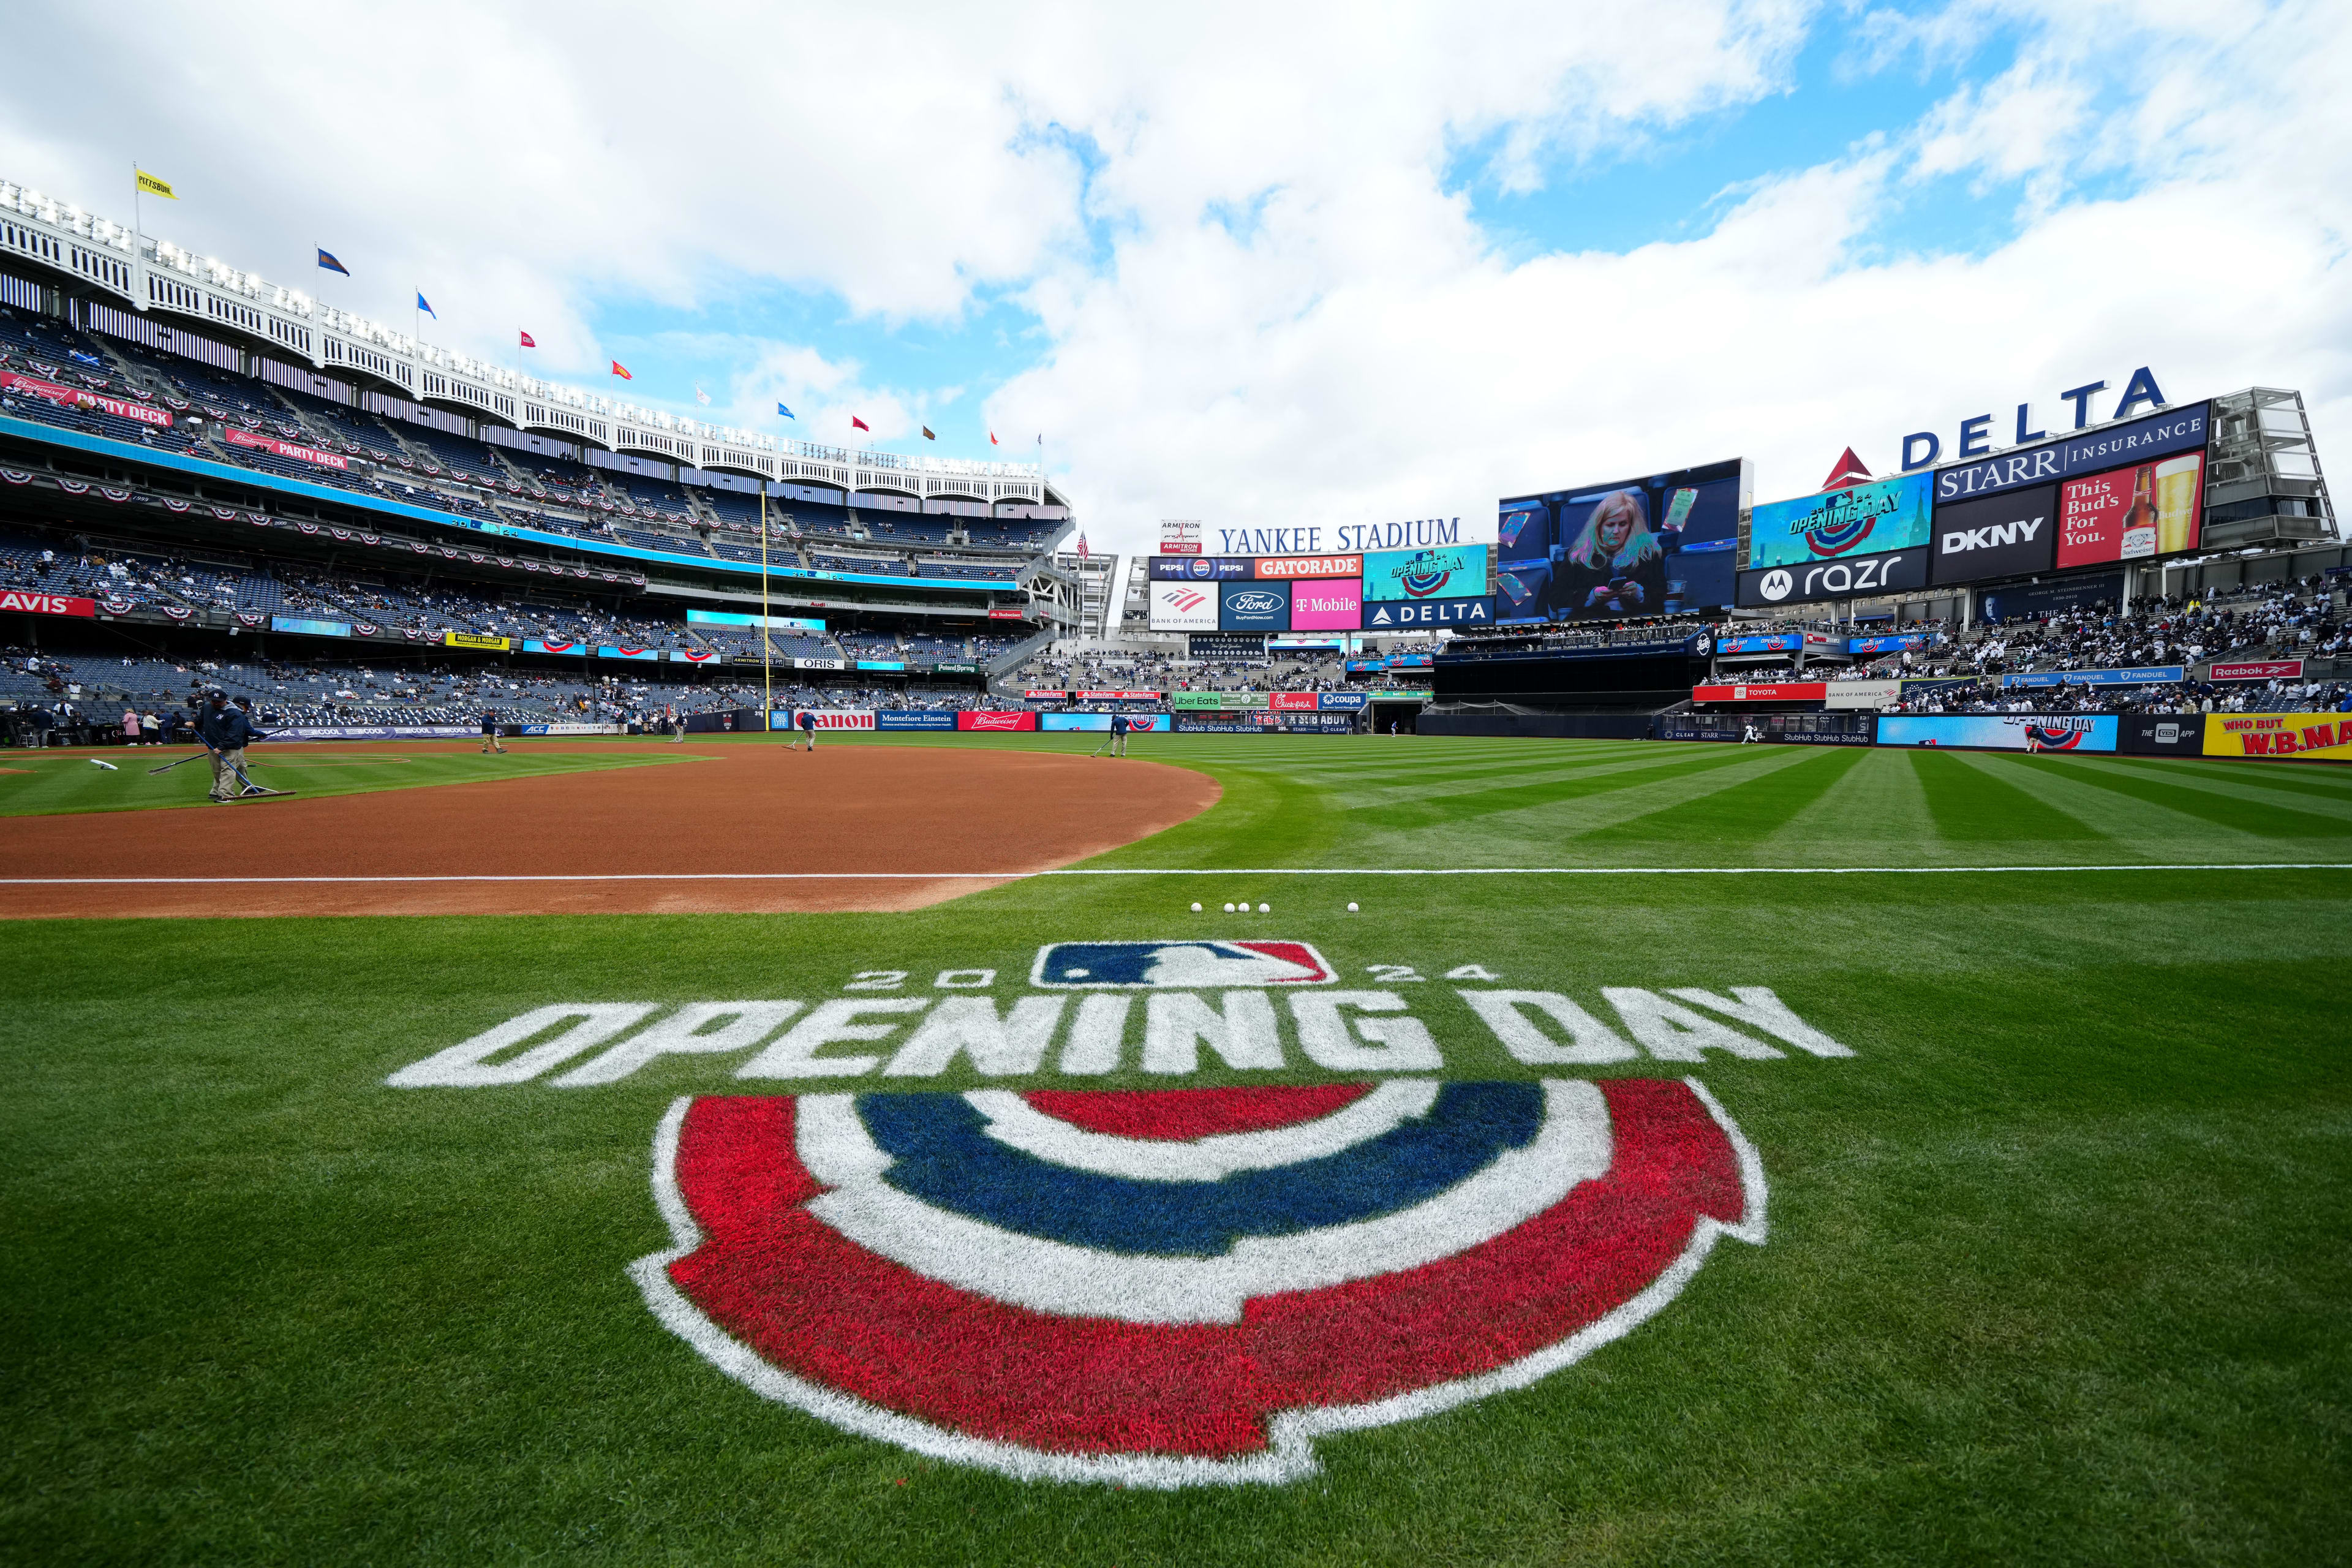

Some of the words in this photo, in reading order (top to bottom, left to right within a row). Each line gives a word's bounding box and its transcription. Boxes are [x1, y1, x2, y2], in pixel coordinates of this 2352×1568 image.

[12, 377, 64, 397] Budweiser
[77, 393, 125, 415] PARTY
[129, 407, 168, 425] DECK
[1902, 366, 2166, 472] DELTA
[235, 433, 271, 447] Budweiser
[279, 443, 314, 461] PARTY
[317, 452, 344, 468] DECK
[1940, 450, 2060, 498] STARR
[2072, 417, 2201, 462] INSURANCE
[2067, 480, 2111, 499] This
[1789, 503, 1858, 535] OPENING
[1863, 490, 1903, 519] DAY
[2067, 494, 2119, 515] Bud's
[451, 519, 467, 528] 20
[2065, 516, 2098, 531] For
[1218, 527, 1321, 553] YANKEE
[1337, 517, 1461, 551] STADIUM
[1942, 517, 2045, 555] DKNY
[2065, 532, 2105, 546] You.
[2122, 546, 2154, 556] Budweiser
[1261, 558, 1357, 575] GATORADE
[1390, 560, 1438, 578] OPENING
[1441, 554, 1468, 573] DAY
[1805, 556, 1902, 595] razr
[2057, 584, 2097, 593] STEINBRENNER
[0, 593, 67, 613] AVIS
[1236, 594, 1274, 610] Ford
[1311, 598, 1357, 611] Mobile
[1400, 602, 1486, 622] DELTA
[2038, 609, 2059, 618] THE
[804, 659, 835, 669] ORIS
[957, 664, 975, 673] Spring
[2215, 666, 2263, 677] Reebok
[1275, 696, 1312, 709] Chick-fil-A
[1334, 696, 1361, 705] coupa
[976, 716, 1017, 725] Budweiser
[2074, 716, 2096, 732] DAY
[2223, 720, 2253, 731] WHO
[2256, 718, 2284, 729] BUT
[843, 969, 997, 990] 20
[1366, 963, 1501, 983] 24
[381, 988, 1444, 1089] OPENING
[1455, 984, 1860, 1066] DAY
